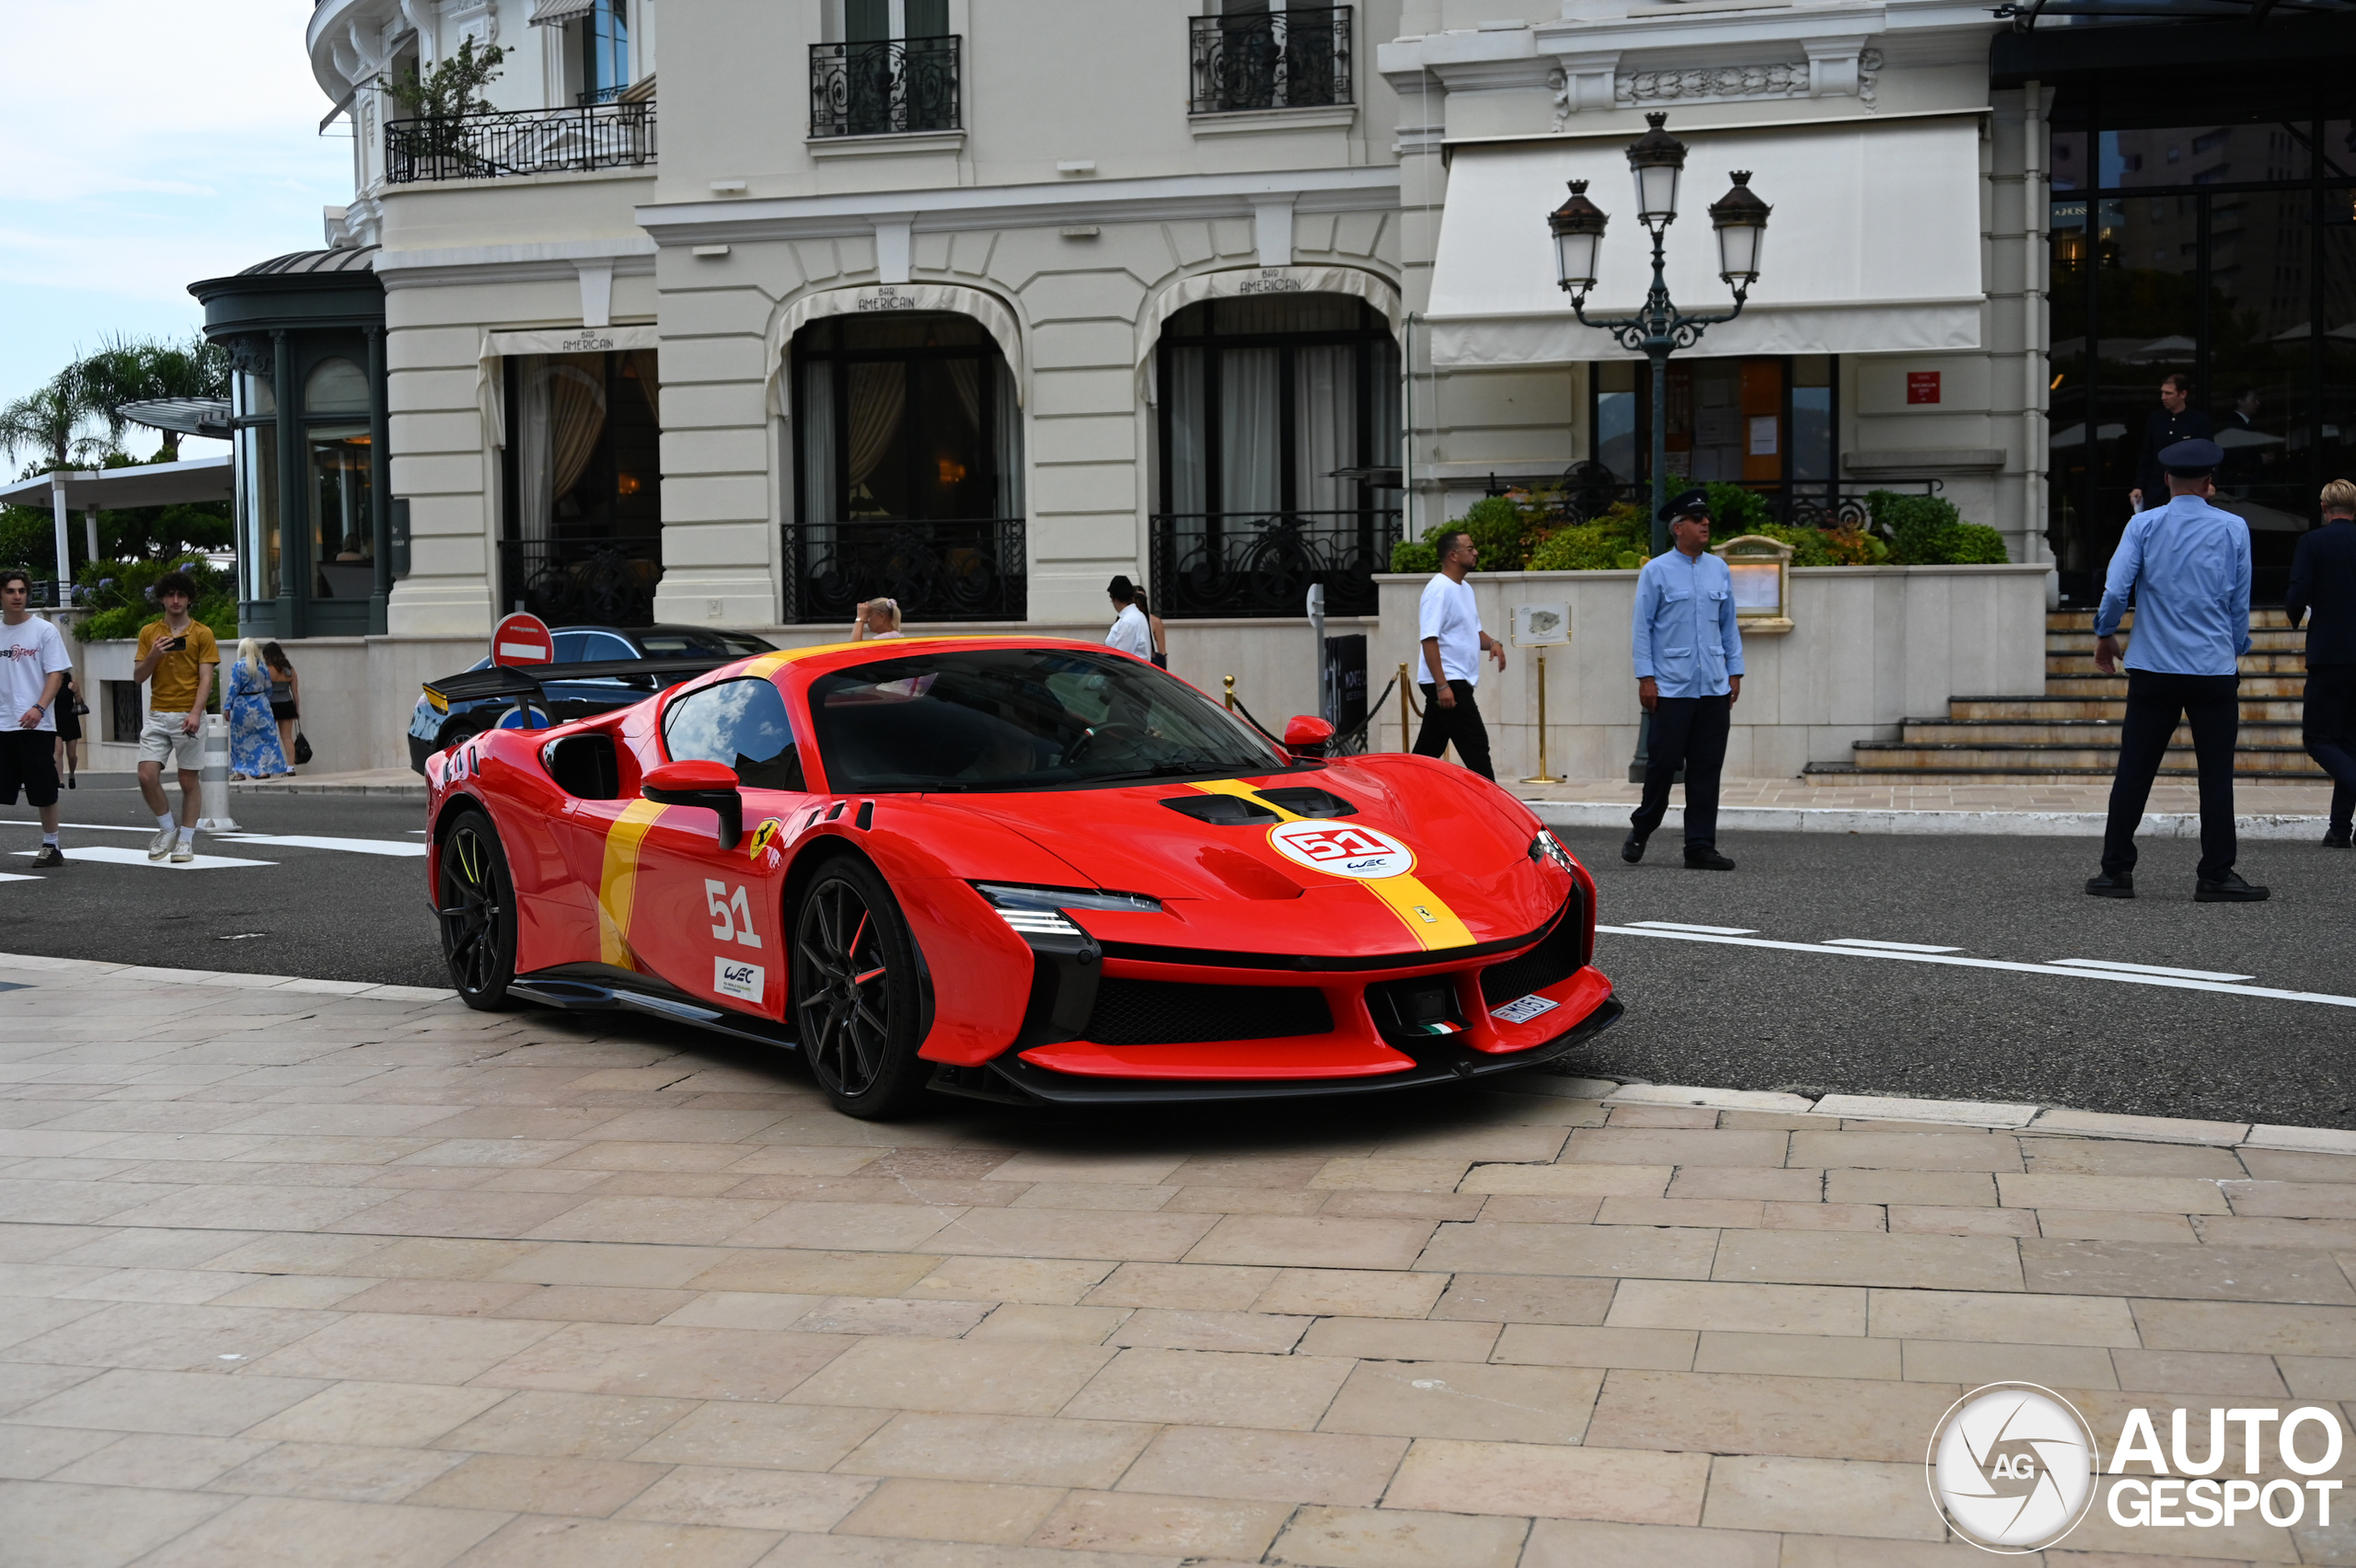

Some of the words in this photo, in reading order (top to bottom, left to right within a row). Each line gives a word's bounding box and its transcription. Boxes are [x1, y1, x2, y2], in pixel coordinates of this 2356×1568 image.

[1262, 269, 1279, 279] BAR
[878, 286, 895, 296] BAR
[1240, 278, 1301, 294] AMERICAIN
[858, 296, 915, 310] AMERICAIN
[581, 330, 595, 340] BAR
[562, 338, 614, 352] AMERICAIN
[1285, 830, 1392, 860] 51
[1346, 859, 1387, 869] WEC
[704, 878, 763, 950] 51
[723, 966, 755, 984] WEC
